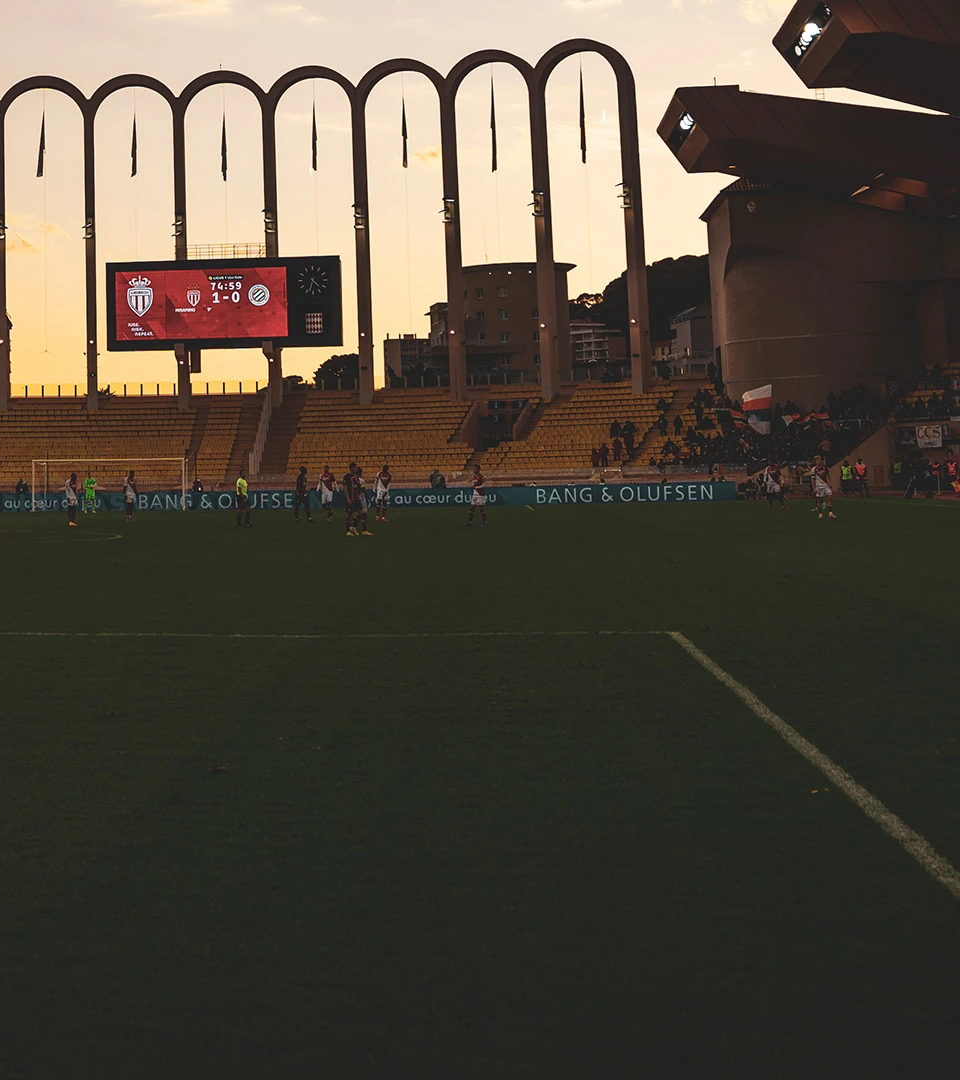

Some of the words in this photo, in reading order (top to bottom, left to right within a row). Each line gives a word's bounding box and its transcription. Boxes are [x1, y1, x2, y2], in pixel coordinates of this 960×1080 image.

[210, 282, 242, 290] 74:59
[395, 495, 412, 505] au
[454, 490, 472, 503] du
[536, 487, 592, 504] BANG
[601, 487, 613, 502] &
[619, 484, 714, 502] OLUFSEN
[4, 499, 21, 509] au
[139, 494, 192, 510] BANG
[201, 494, 212, 509] &
